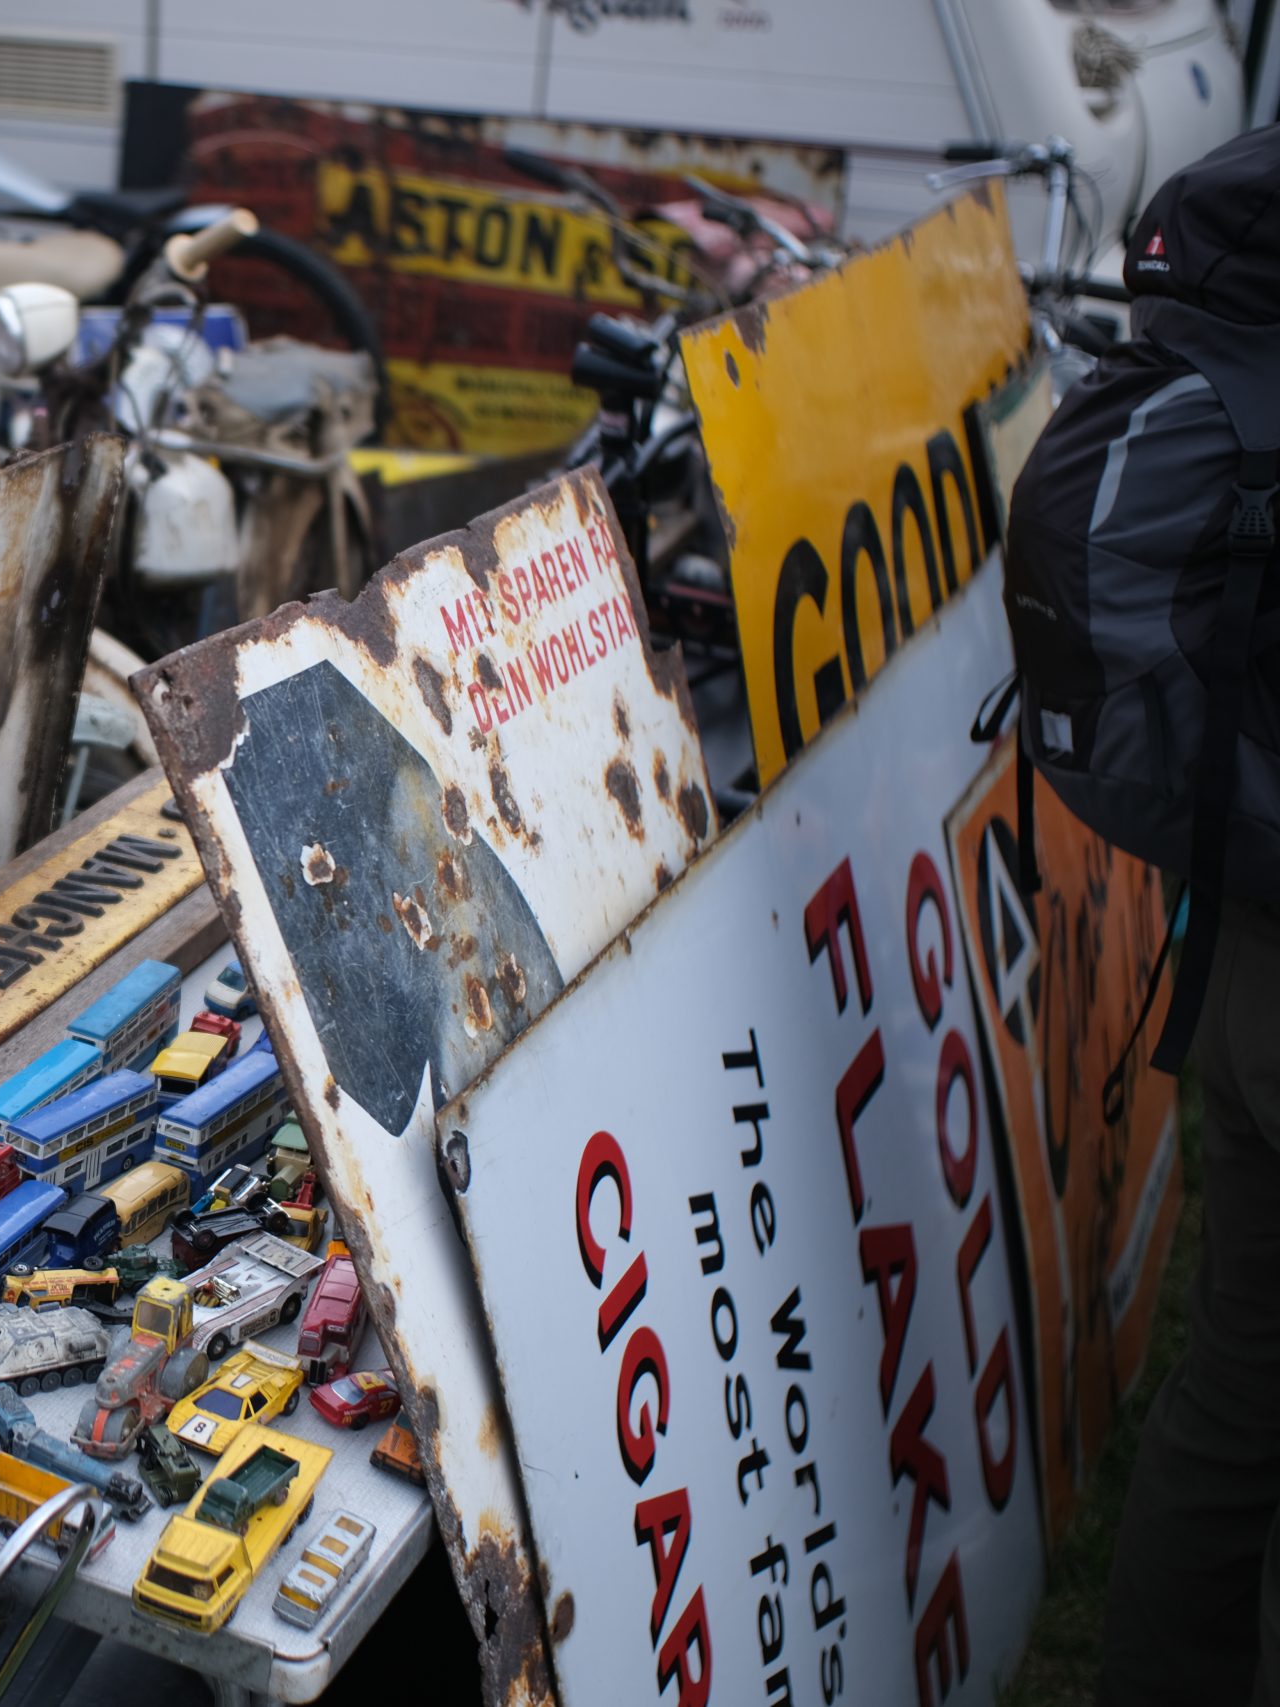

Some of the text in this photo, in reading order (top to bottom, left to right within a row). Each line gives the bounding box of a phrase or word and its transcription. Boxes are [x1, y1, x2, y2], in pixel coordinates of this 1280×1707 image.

[439, 589, 496, 657] MIT
[497, 535, 590, 626] SPAREN
[773, 402, 1000, 764] GOOD
[575, 1130, 713, 1707] CIGAR
[688, 1191, 771, 1508] most
[721, 1026, 848, 1707] The world's
[803, 855, 971, 1707] FLAKE
[905, 850, 1019, 1514] GOLD
